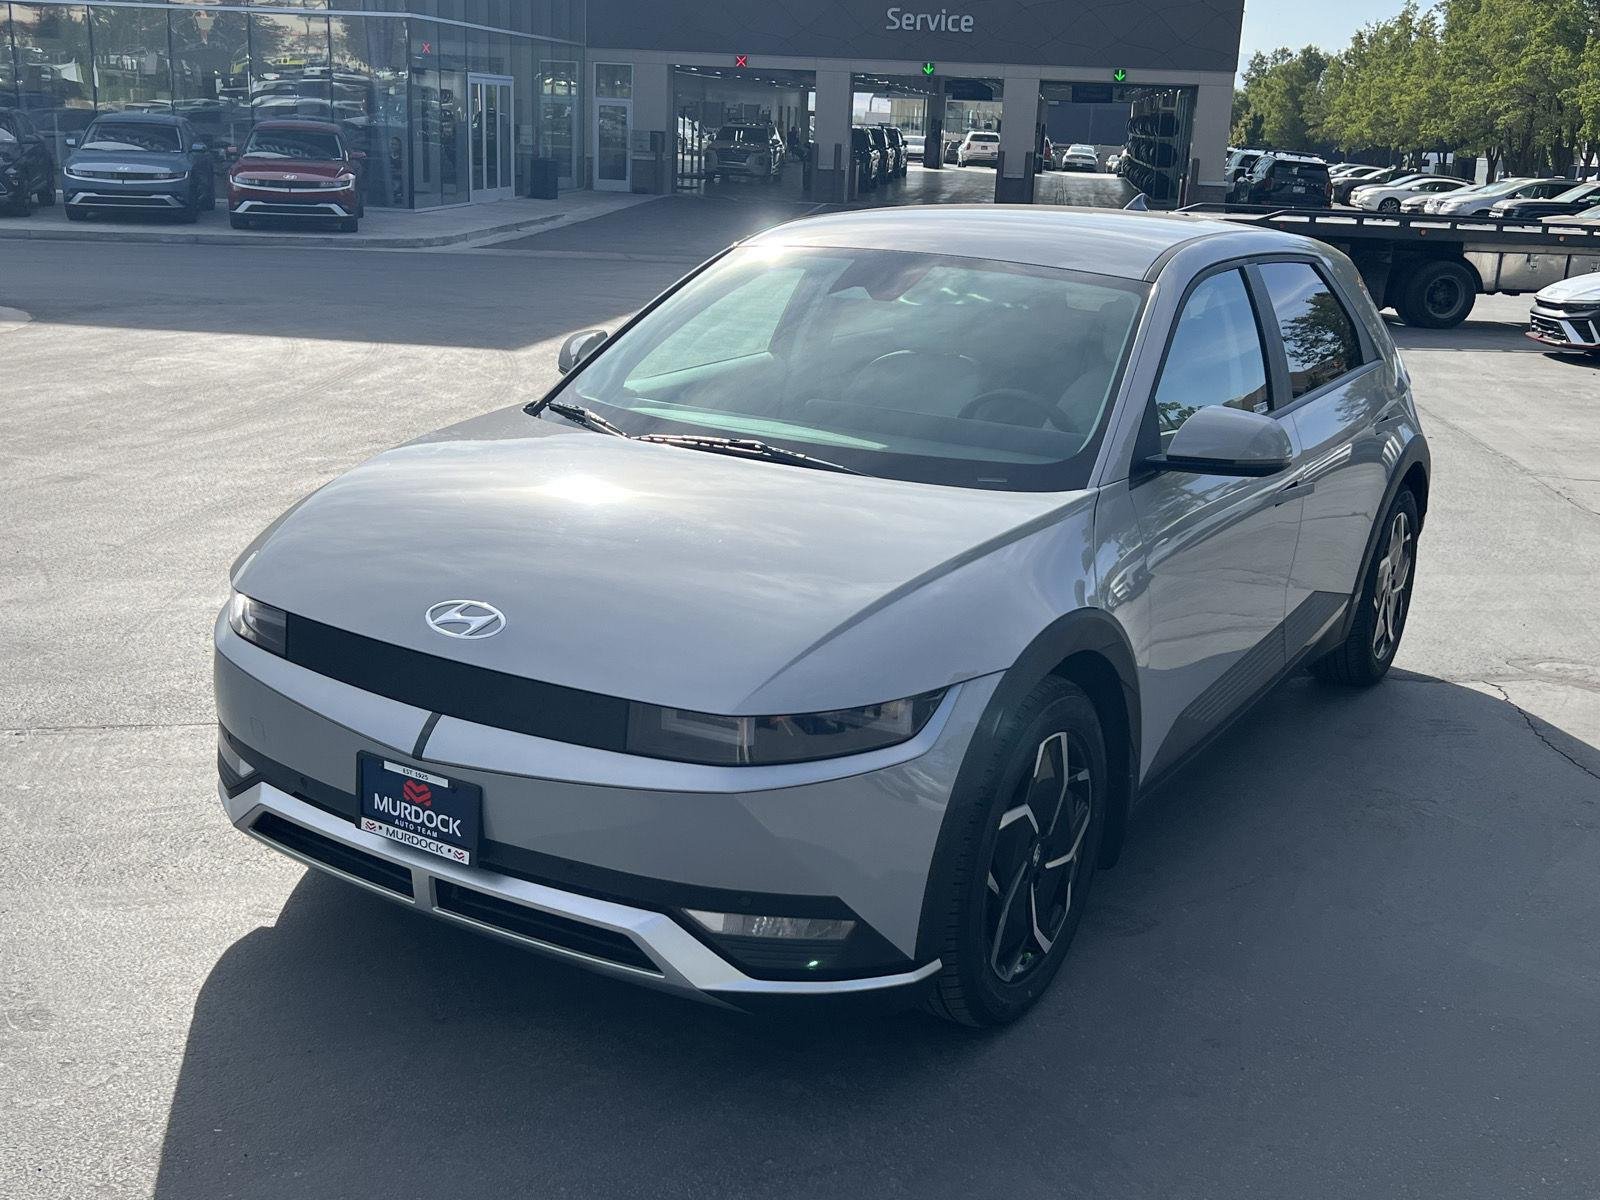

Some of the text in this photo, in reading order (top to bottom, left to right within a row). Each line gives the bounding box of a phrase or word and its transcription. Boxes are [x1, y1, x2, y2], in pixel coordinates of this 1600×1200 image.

[886, 7, 974, 33] Service
[402, 767, 429, 781] EST 1925
[374, 792, 462, 837] MURDOCK
[385, 826, 444, 855] MURDOCK
[394, 818, 438, 838] AUTO TEAM
